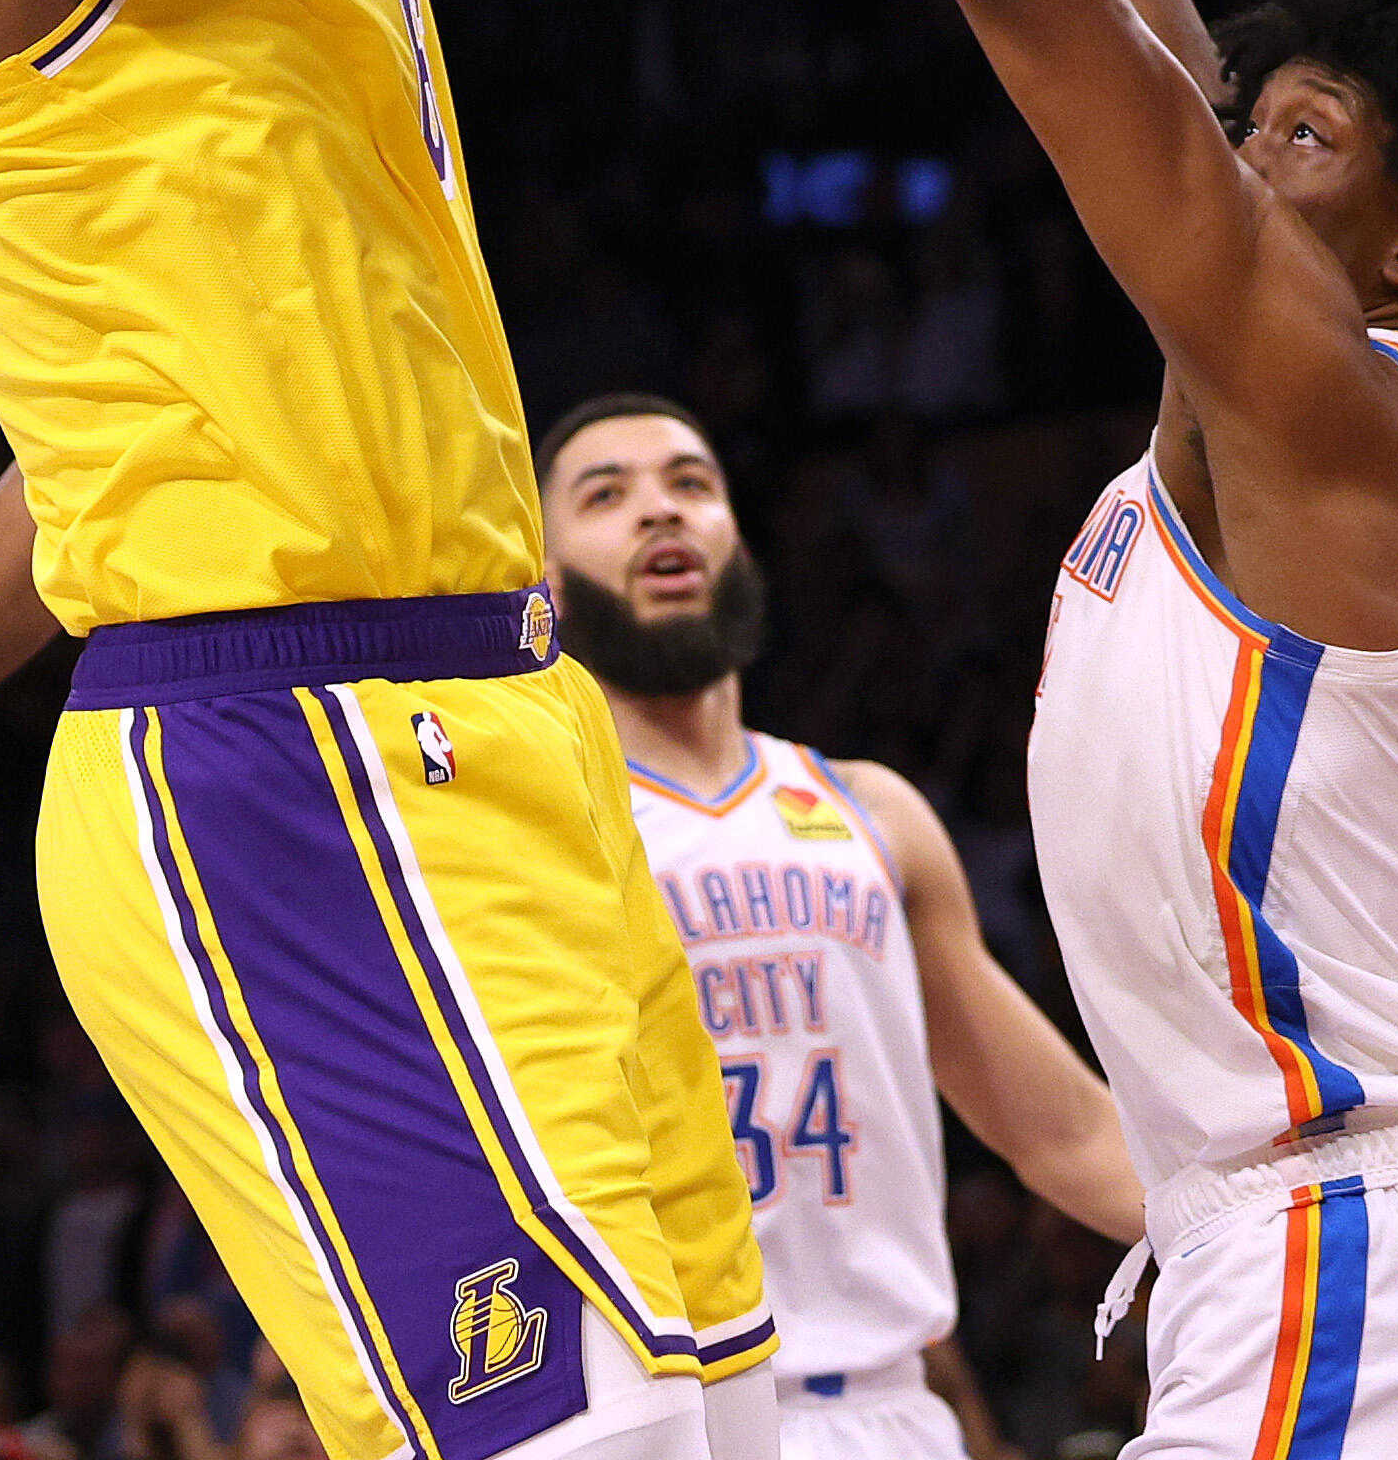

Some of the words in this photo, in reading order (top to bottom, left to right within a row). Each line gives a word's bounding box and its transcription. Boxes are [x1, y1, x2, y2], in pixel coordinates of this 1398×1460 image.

[428, 768, 446, 784] NBA
[656, 858, 893, 962] LAHOMA
[692, 950, 826, 1038] CITY
[718, 1048, 857, 1208] 34
